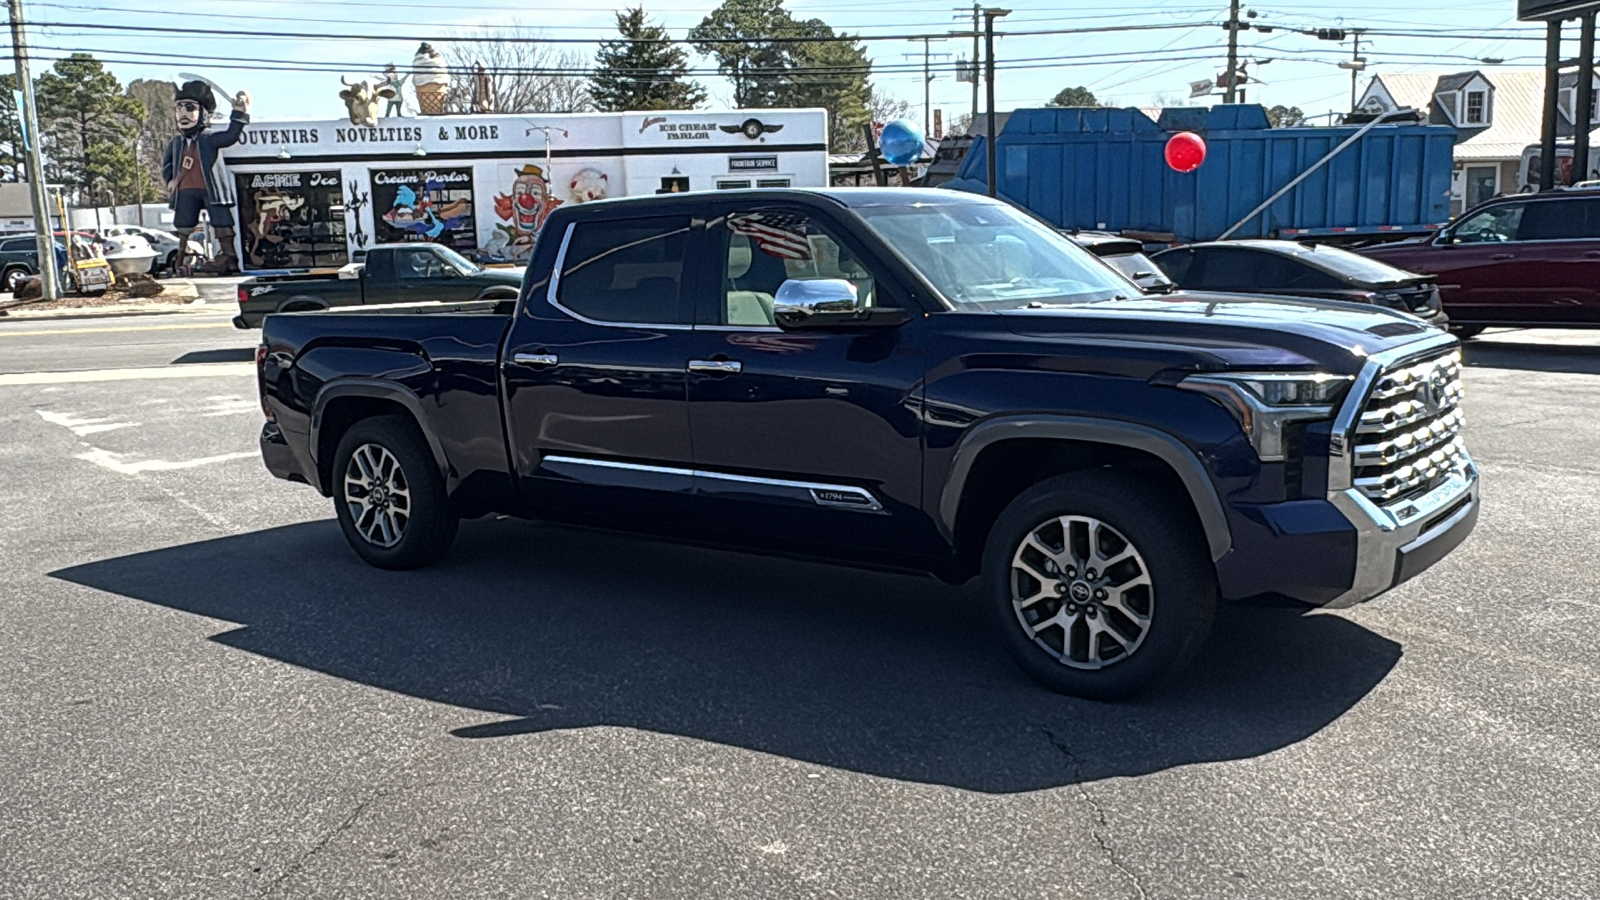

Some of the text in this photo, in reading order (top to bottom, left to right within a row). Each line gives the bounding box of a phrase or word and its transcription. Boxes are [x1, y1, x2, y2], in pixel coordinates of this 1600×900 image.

[659, 123, 677, 132] ICE
[678, 122, 717, 132] CREAM
[238, 125, 499, 145] OUVENIRS NOVELTIES & MORE
[667, 132, 710, 140] PARLOR
[731, 158, 776, 168] FOUNTAIN SERVICE
[251, 172, 339, 188] ACME Ice
[374, 170, 470, 185] Cream Parlor
